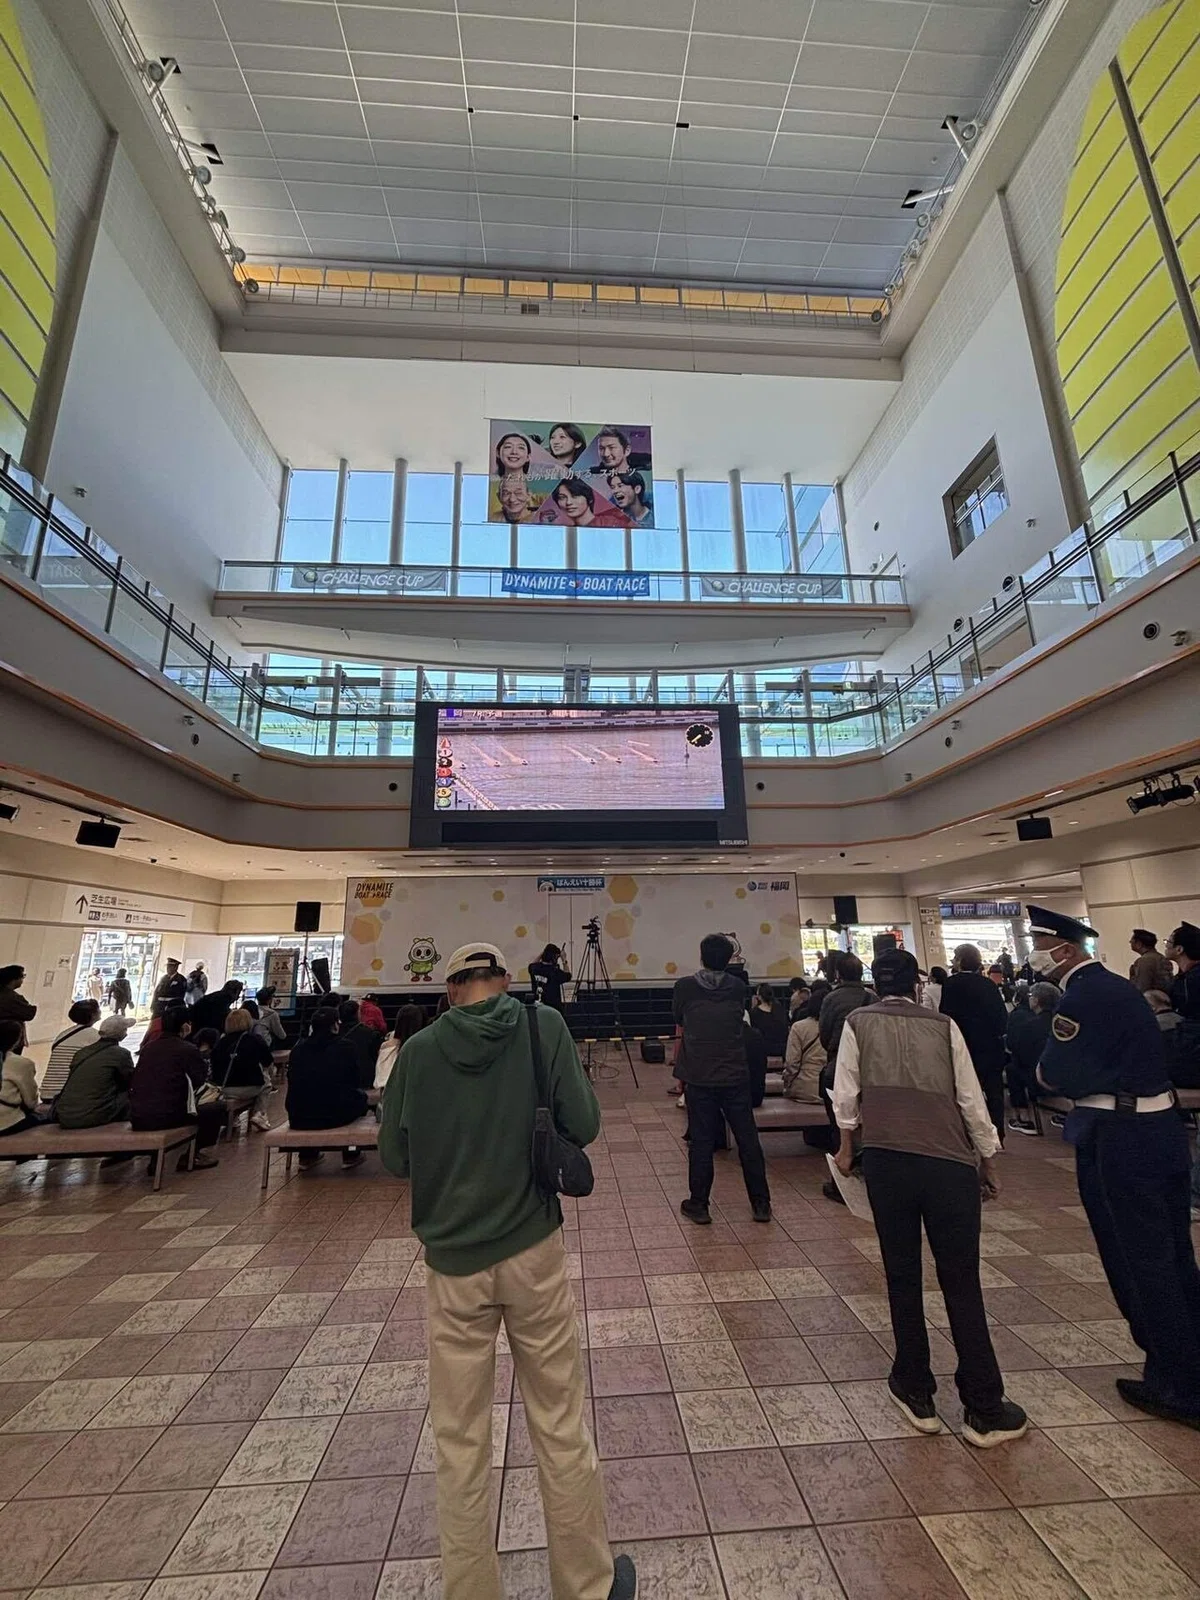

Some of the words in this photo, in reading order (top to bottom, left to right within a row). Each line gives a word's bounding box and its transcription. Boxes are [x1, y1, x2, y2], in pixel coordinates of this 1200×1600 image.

[322, 572, 395, 586] CHALLENGE
[397, 575, 424, 587] CUP
[505, 573, 568, 590] DYNAMITE
[583, 577, 613, 590] BOAT
[615, 577, 646, 591] RACE
[729, 581, 795, 594] CHALLENGE
[797, 583, 822, 595] CUP
[355, 882, 394, 892] DYNAMITE
[770, 881, 790, 891] 福岡
[354, 891, 371, 899] BOAT
[376, 891, 393, 899] RACE
